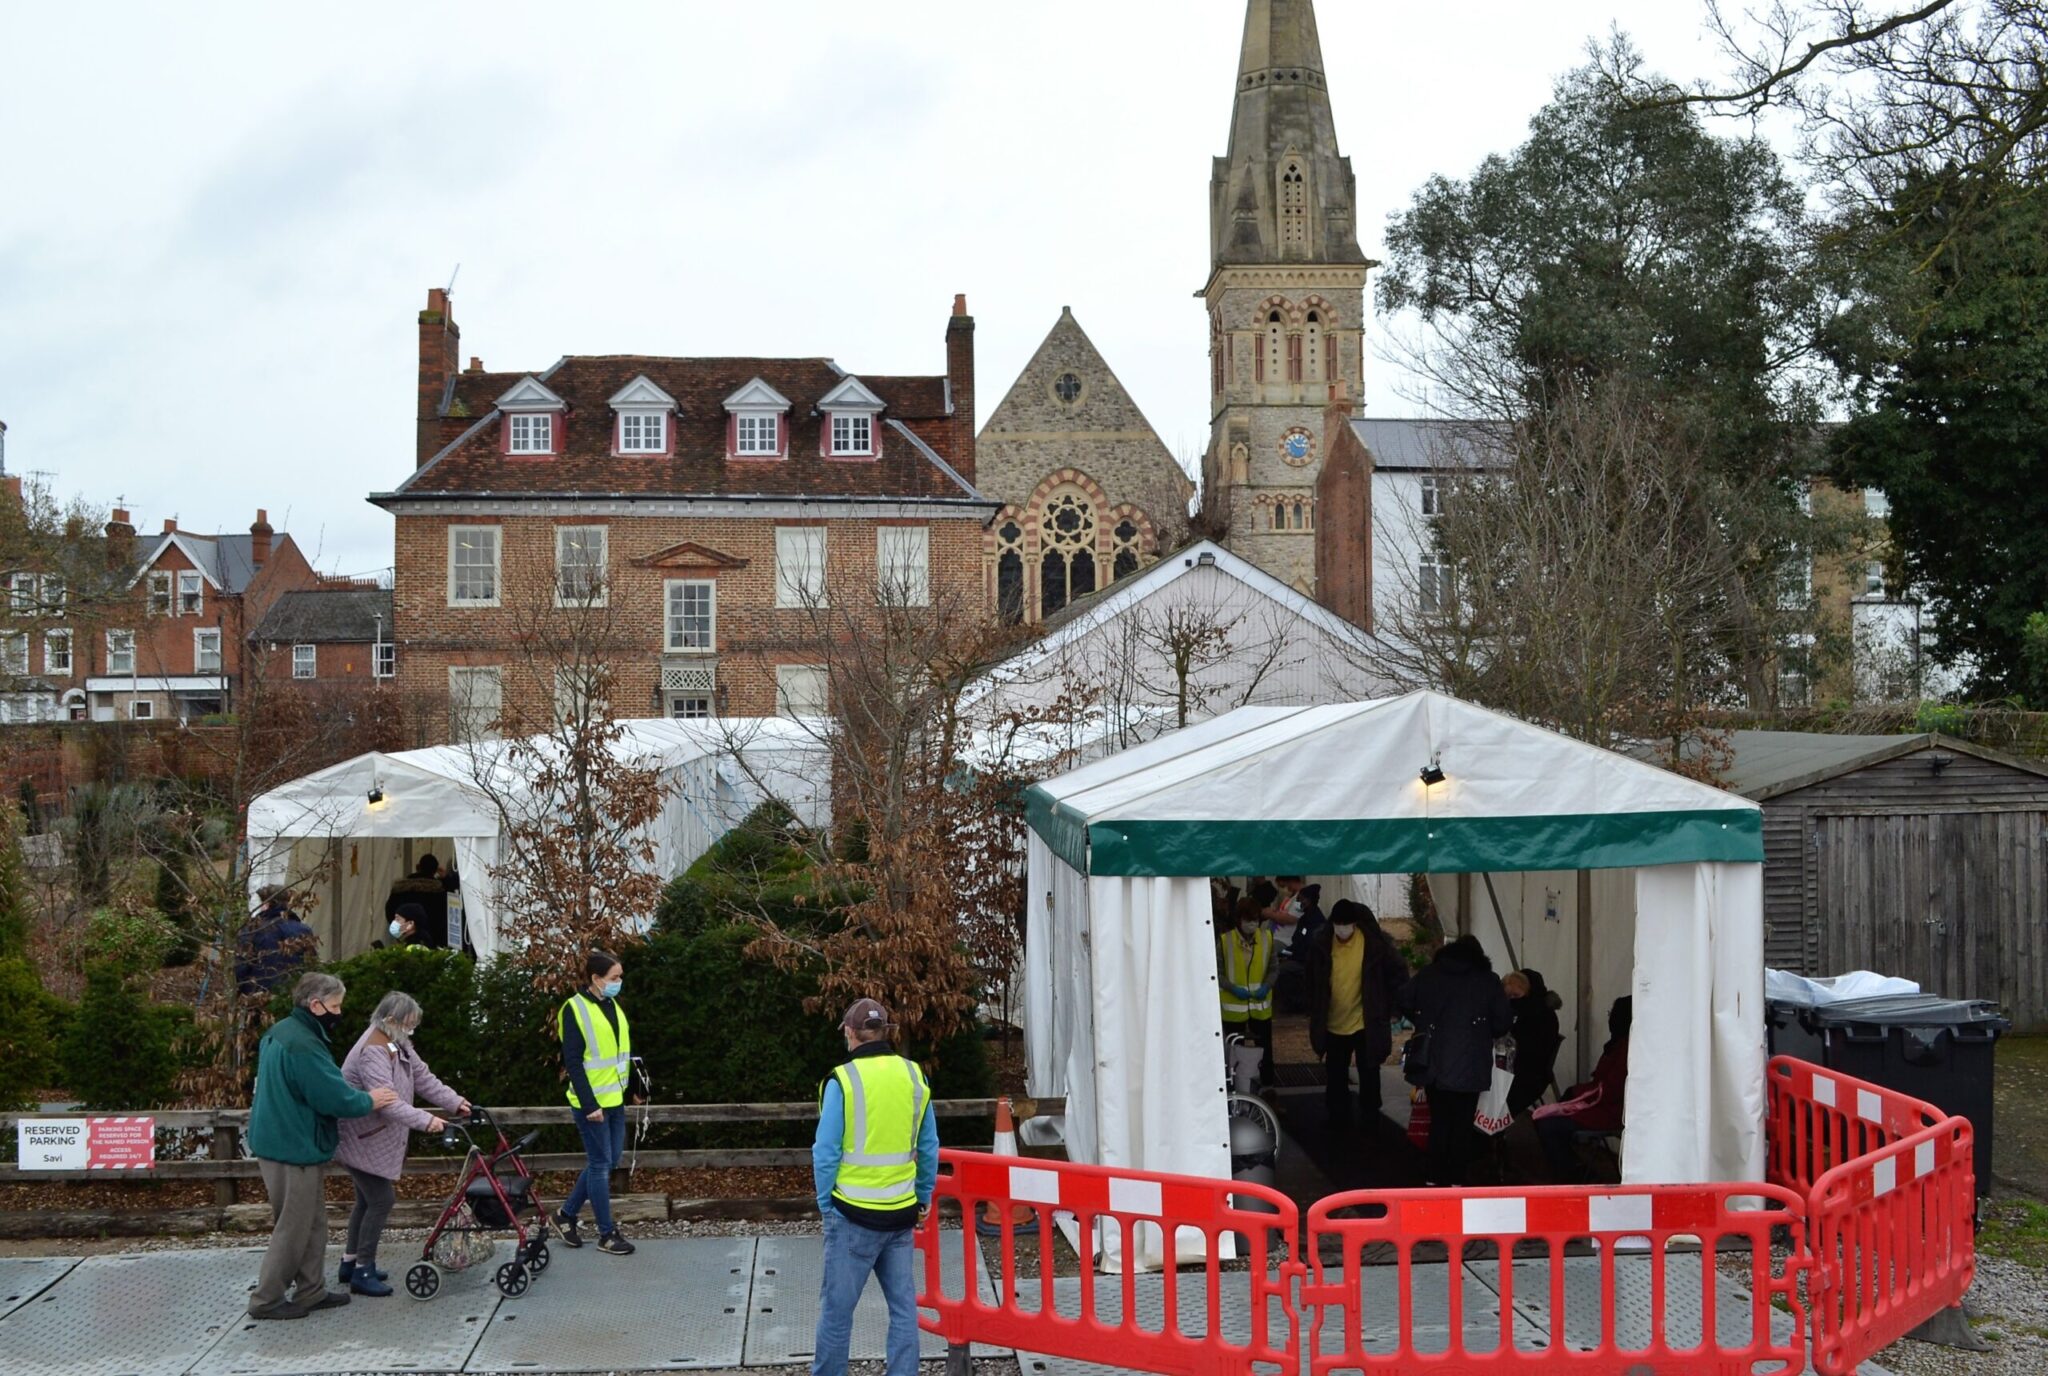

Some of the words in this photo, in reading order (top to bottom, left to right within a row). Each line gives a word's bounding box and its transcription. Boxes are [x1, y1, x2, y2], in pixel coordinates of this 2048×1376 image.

[25, 1126, 80, 1135] RESERVED
[30, 1136, 76, 1145] PARKING
[43, 1154, 63, 1162] Savi
